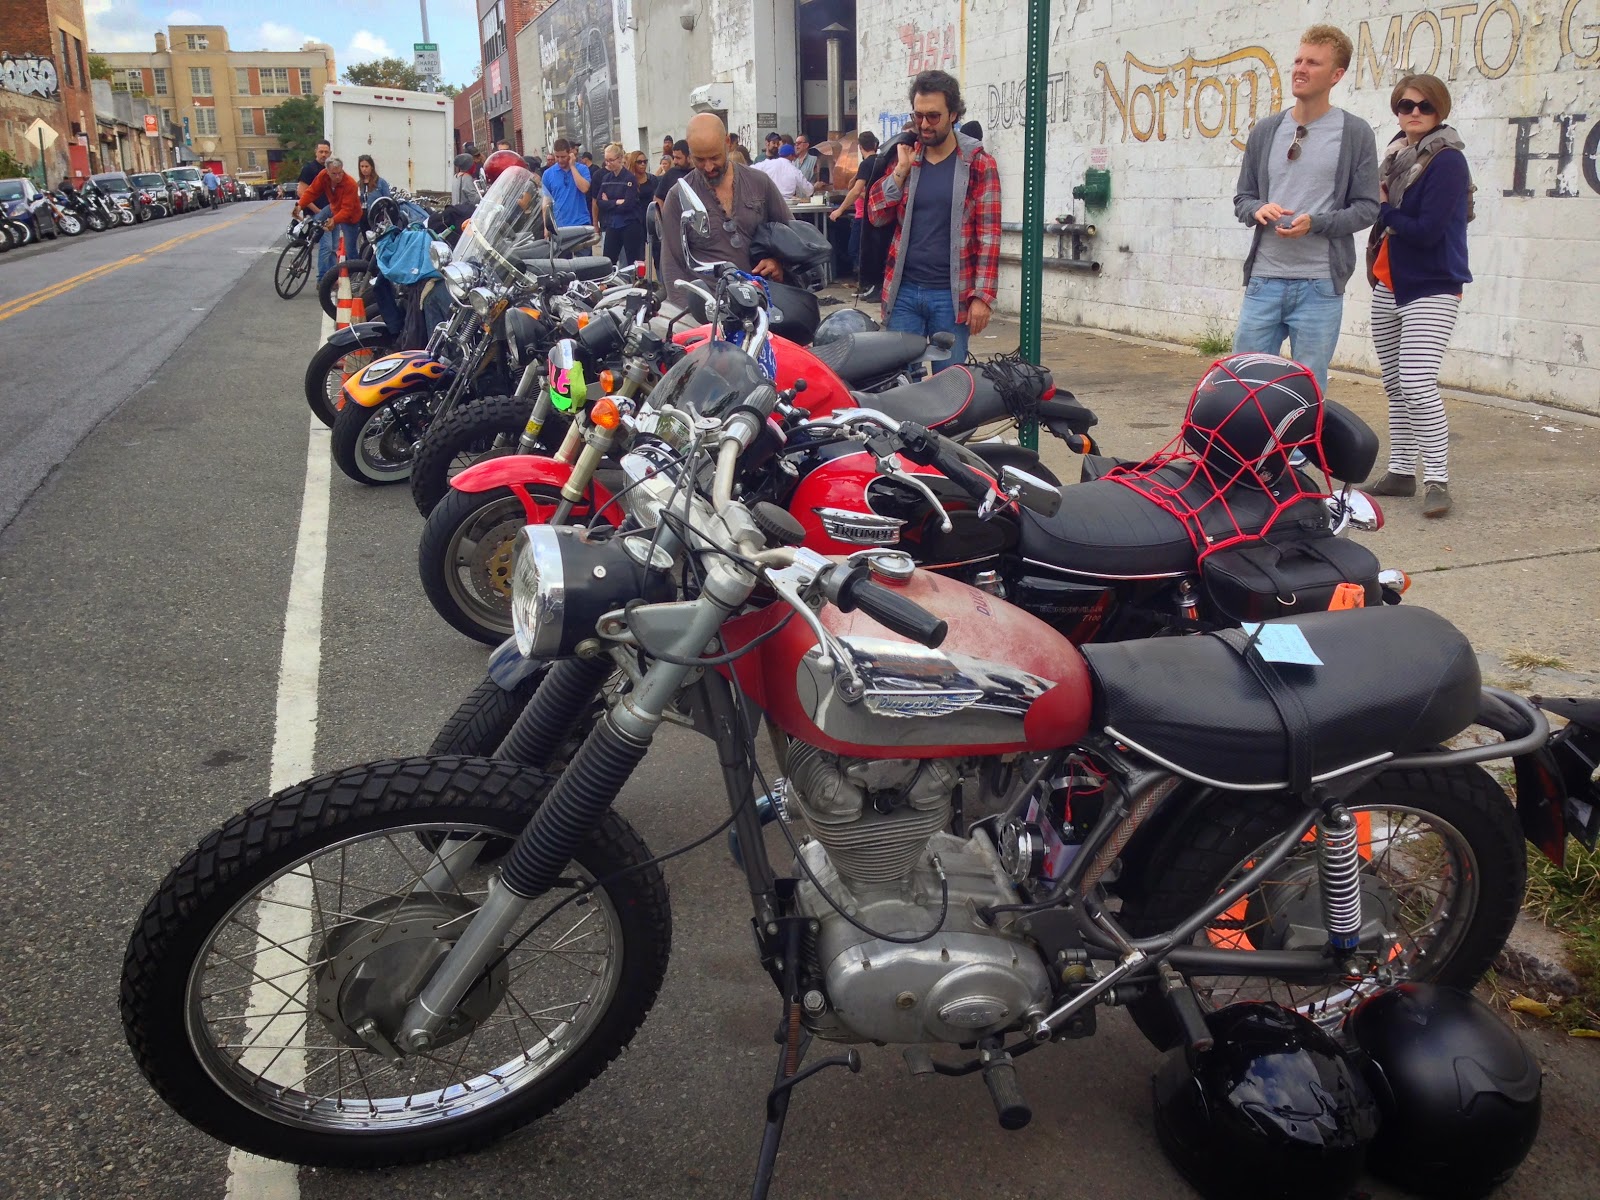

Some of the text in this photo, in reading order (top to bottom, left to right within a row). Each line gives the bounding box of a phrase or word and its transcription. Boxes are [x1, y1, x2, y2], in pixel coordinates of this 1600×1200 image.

[906, 24, 957, 77] BSA
[1355, 0, 1521, 90] MOTO
[987, 70, 1069, 131] DUCTI
[1094, 46, 1282, 151] Norton
[833, 523, 895, 540] TRIUMPH
